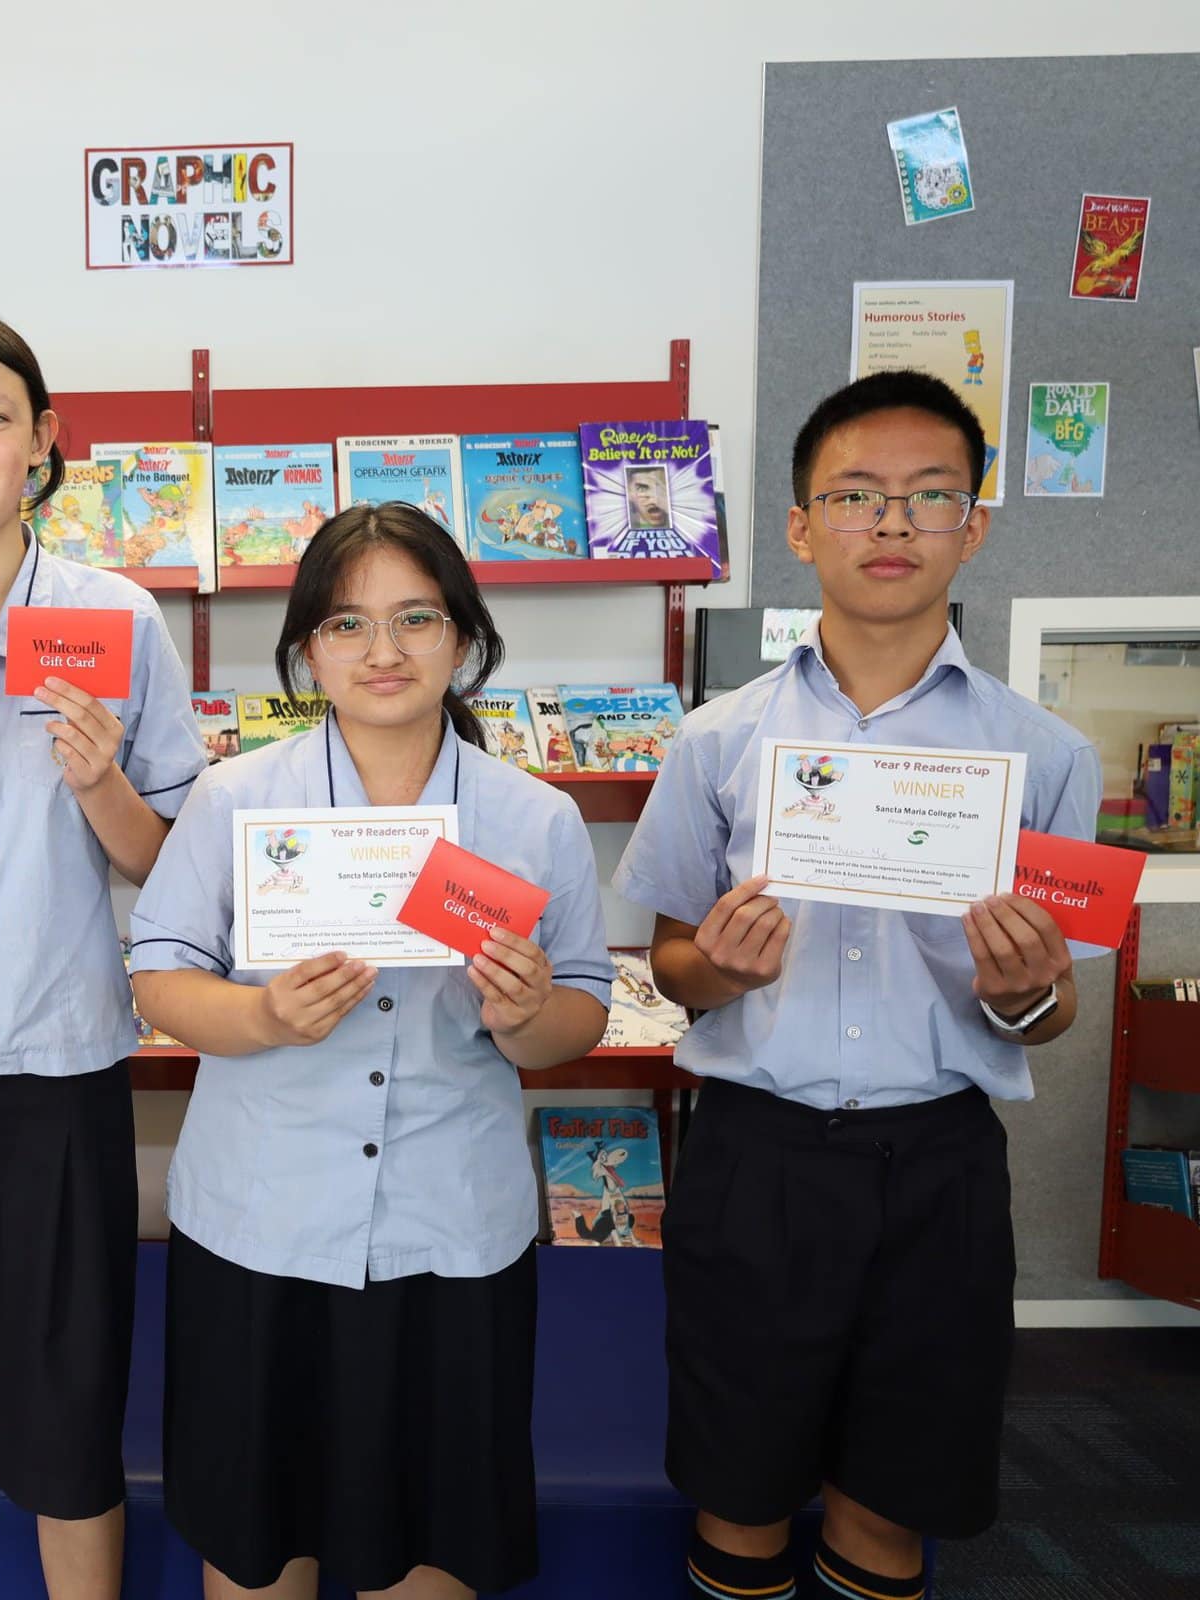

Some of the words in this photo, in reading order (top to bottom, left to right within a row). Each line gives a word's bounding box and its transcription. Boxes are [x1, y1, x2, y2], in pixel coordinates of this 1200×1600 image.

[91, 153, 277, 206] GRAPHIC
[1083, 213, 1145, 236] BEAST
[120, 209, 284, 262] NOVELS
[864, 312, 925, 322] Humorous
[927, 311, 967, 322] Stories
[1045, 384, 1097, 399] ROALD
[1044, 399, 1096, 417] DAHL
[1055, 418, 1085, 441] BFG
[496, 452, 543, 466] Asterix
[588, 447, 636, 461] Believe
[639, 446, 652, 459] It
[654, 449, 670, 459] or
[671, 444, 701, 459] Not!
[136, 471, 151, 482] the
[153, 471, 191, 484] Banquet
[225, 467, 281, 486] Asterix
[282, 468, 323, 484] NORMANS
[354, 467, 407, 478] OPERATION
[410, 465, 447, 477] GETAFIX
[626, 530, 680, 539] ENTER
[618, 538, 641, 551] IF
[645, 538, 687, 551] YOU
[31, 639, 106, 656] Whitcoulls
[40, 656, 64, 668] Gift
[66, 656, 96, 668] Card
[565, 697, 673, 714] OBELIX
[597, 713, 627, 721] AND
[630, 713, 657, 721] CO.
[873, 759, 900, 770] Year
[903, 760, 910, 770] 9
[913, 762, 962, 775] Readers
[965, 765, 991, 778] Cup
[893, 779, 966, 800] WINNER
[875, 804, 902, 815] Sancta
[903, 806, 926, 816] Maria
[928, 809, 958, 821] College
[959, 811, 980, 820] Team
[331, 828, 355, 838] Year
[357, 828, 363, 837] 9
[366, 827, 407, 837] Readers
[409, 826, 430, 839] Cup
[350, 845, 412, 862] WINNER
[338, 872, 361, 880] Sancta
[362, 871, 381, 879] Maria
[383, 871, 407, 881] College
[1015, 865, 1104, 896] Whitcoulls
[445, 880, 512, 924] Whitcoulls
[1019, 884, 1048, 900] Gift
[1051, 890, 1089, 909] Card
[444, 899, 466, 918] Gift
[468, 911, 497, 931] Card
[608, 1117, 649, 1139] Flats
